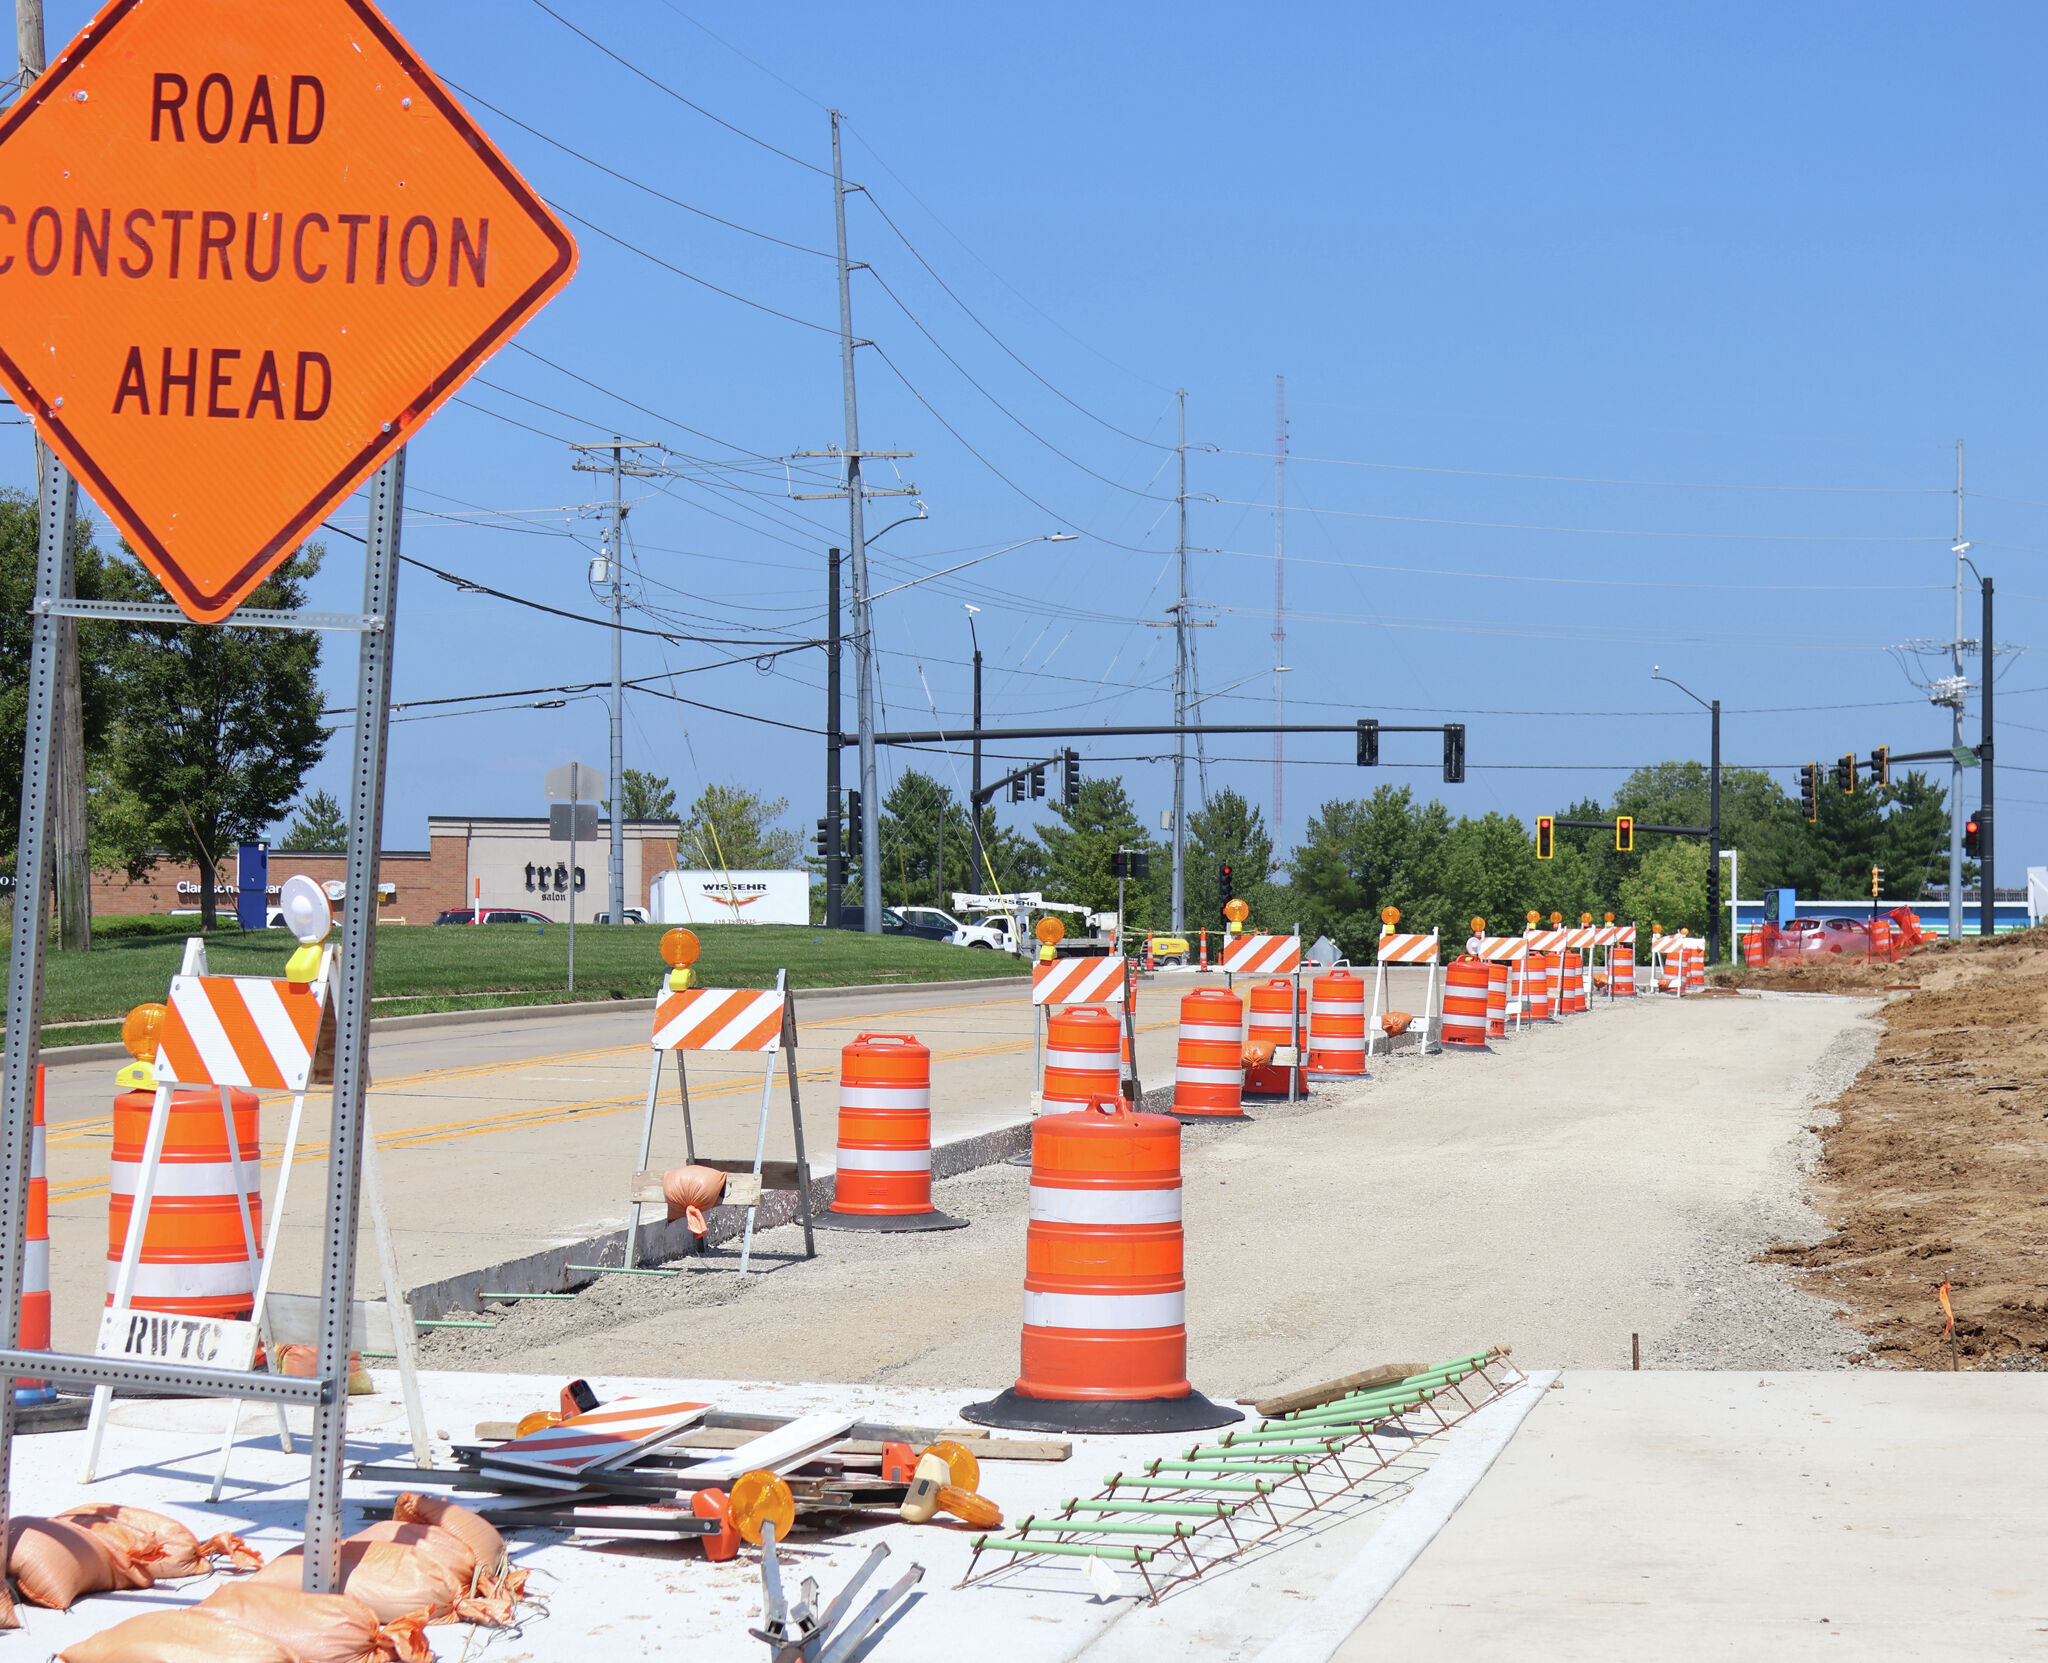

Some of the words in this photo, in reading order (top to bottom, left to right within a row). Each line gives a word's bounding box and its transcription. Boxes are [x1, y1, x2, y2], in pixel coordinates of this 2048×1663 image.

[150, 72, 326, 145] ROAD
[112, 345, 332, 421] AHEAD
[541, 892, 566, 901] salon
[703, 883, 767, 891] WISSEHR
[988, 897, 1037, 907] WISSEHR
[125, 1315, 222, 1361] RWTC
